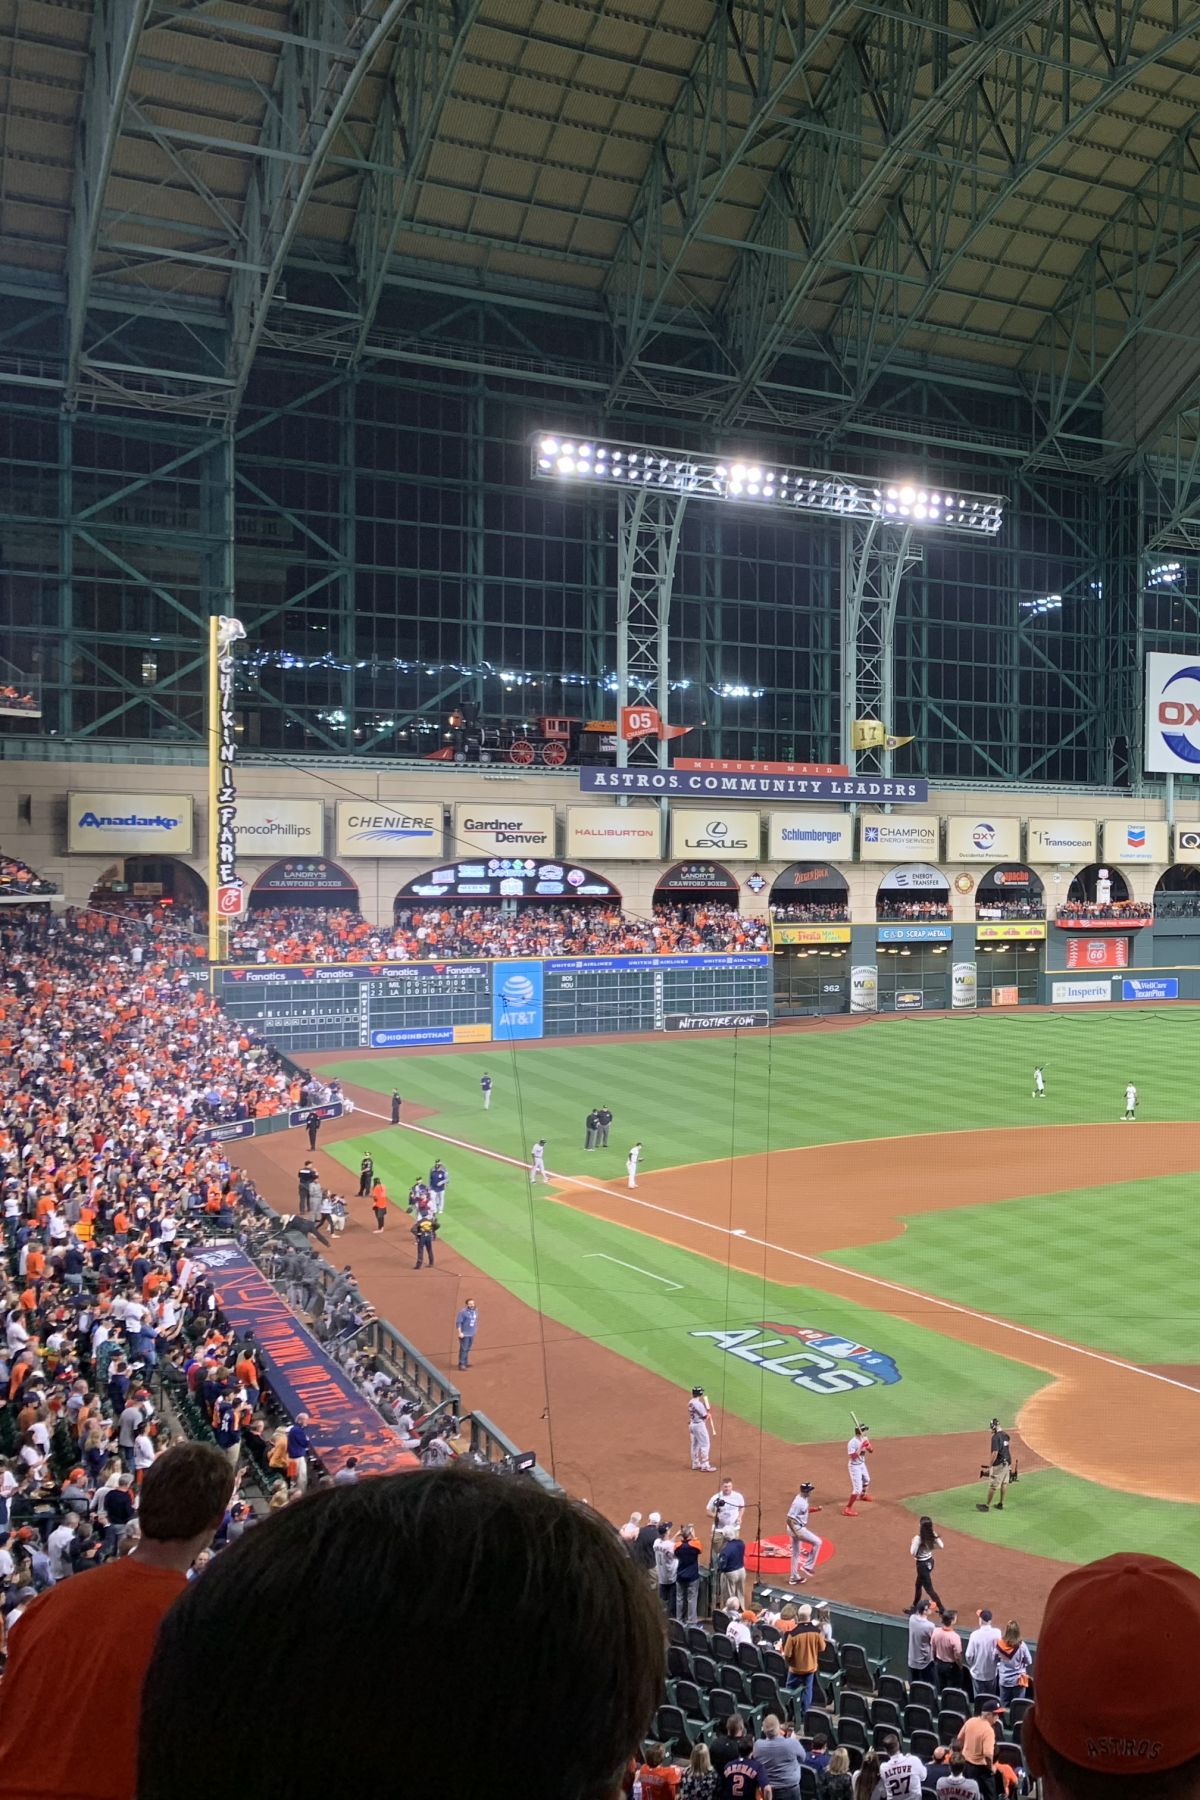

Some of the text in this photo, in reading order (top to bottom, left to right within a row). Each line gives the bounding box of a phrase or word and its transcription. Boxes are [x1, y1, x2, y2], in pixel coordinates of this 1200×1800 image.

[218, 656, 236, 762] CHIKIN
[629, 713, 652, 729] 05
[858, 726, 878, 741] 17
[694, 762, 833, 774] MINUTE MAID
[594, 773, 916, 796] ASTROS COMMUNITY LEADERS
[78, 812, 178, 829] Anadarko
[348, 817, 434, 829] CHENIERE
[464, 819, 522, 830] Gardner
[232, 824, 311, 836] onocoPhillips
[782, 828, 842, 844] Schlumberger
[880, 827, 934, 838] CHAMPION
[973, 832, 996, 840] OXY
[496, 832, 547, 844] Denver
[685, 840, 748, 848] LEXUS
[1045, 837, 1092, 847] Transocean
[219, 808, 236, 883] FARE
[906, 930, 926, 938] SCRAP
[1090, 951, 1104, 959] 66
[246, 966, 481, 981] Fanatics Fanatics Fanatics Fanatics
[1068, 985, 1108, 997] Insperity
[1140, 981, 1167, 989] WellCare
[500, 1011, 536, 1026] AT&T
[679, 1015, 755, 1029] NITTOTIRE.COM
[689, 1329, 875, 1394] ALCS
[1087, 1737, 1163, 1759] ASTROS
[884, 1765, 913, 1778] ALTUVE
[732, 1774, 744, 1796] 2
[889, 1775, 911, 1797] 27
